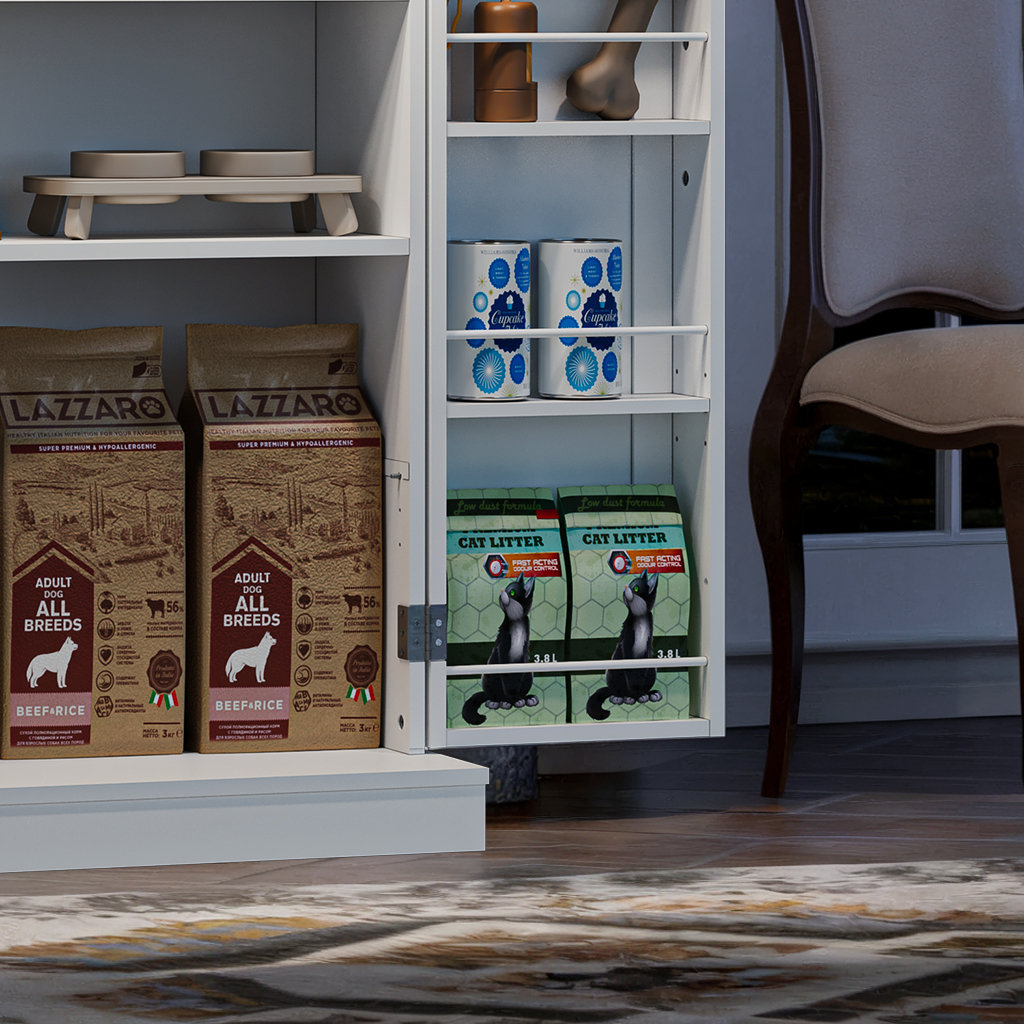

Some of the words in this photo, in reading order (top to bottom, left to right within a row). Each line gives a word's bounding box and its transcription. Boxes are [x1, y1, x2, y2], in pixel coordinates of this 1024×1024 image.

[492, 310, 524, 326] Cupcake
[584, 308, 617, 325] Cupcake
[9, 396, 166, 422] LAZZARO
[207, 393, 362, 418] LAZZARO
[98, 443, 157, 451] HYPOALLERGENIC
[454, 501, 476, 516] Low
[479, 501, 500, 511] dust
[503, 501, 542, 518] formula
[577, 497, 600, 512] Low
[602, 497, 623, 508] dust
[626, 496, 665, 514] formula
[458, 537, 487, 549] CAT
[489, 535, 544, 548] LITTER
[582, 533, 611, 545] CAT
[613, 532, 667, 545] LITTER
[533, 558, 558, 566] ACTING
[35, 577, 72, 589] ADULT
[234, 572, 270, 584] ADULT
[44, 590, 64, 598] DOG
[243, 585, 262, 594] DOG
[36, 600, 70, 617] ALL
[235, 595, 269, 612] ALL
[24, 619, 82, 632] BREEDS
[223, 614, 281, 627] BREEDS
